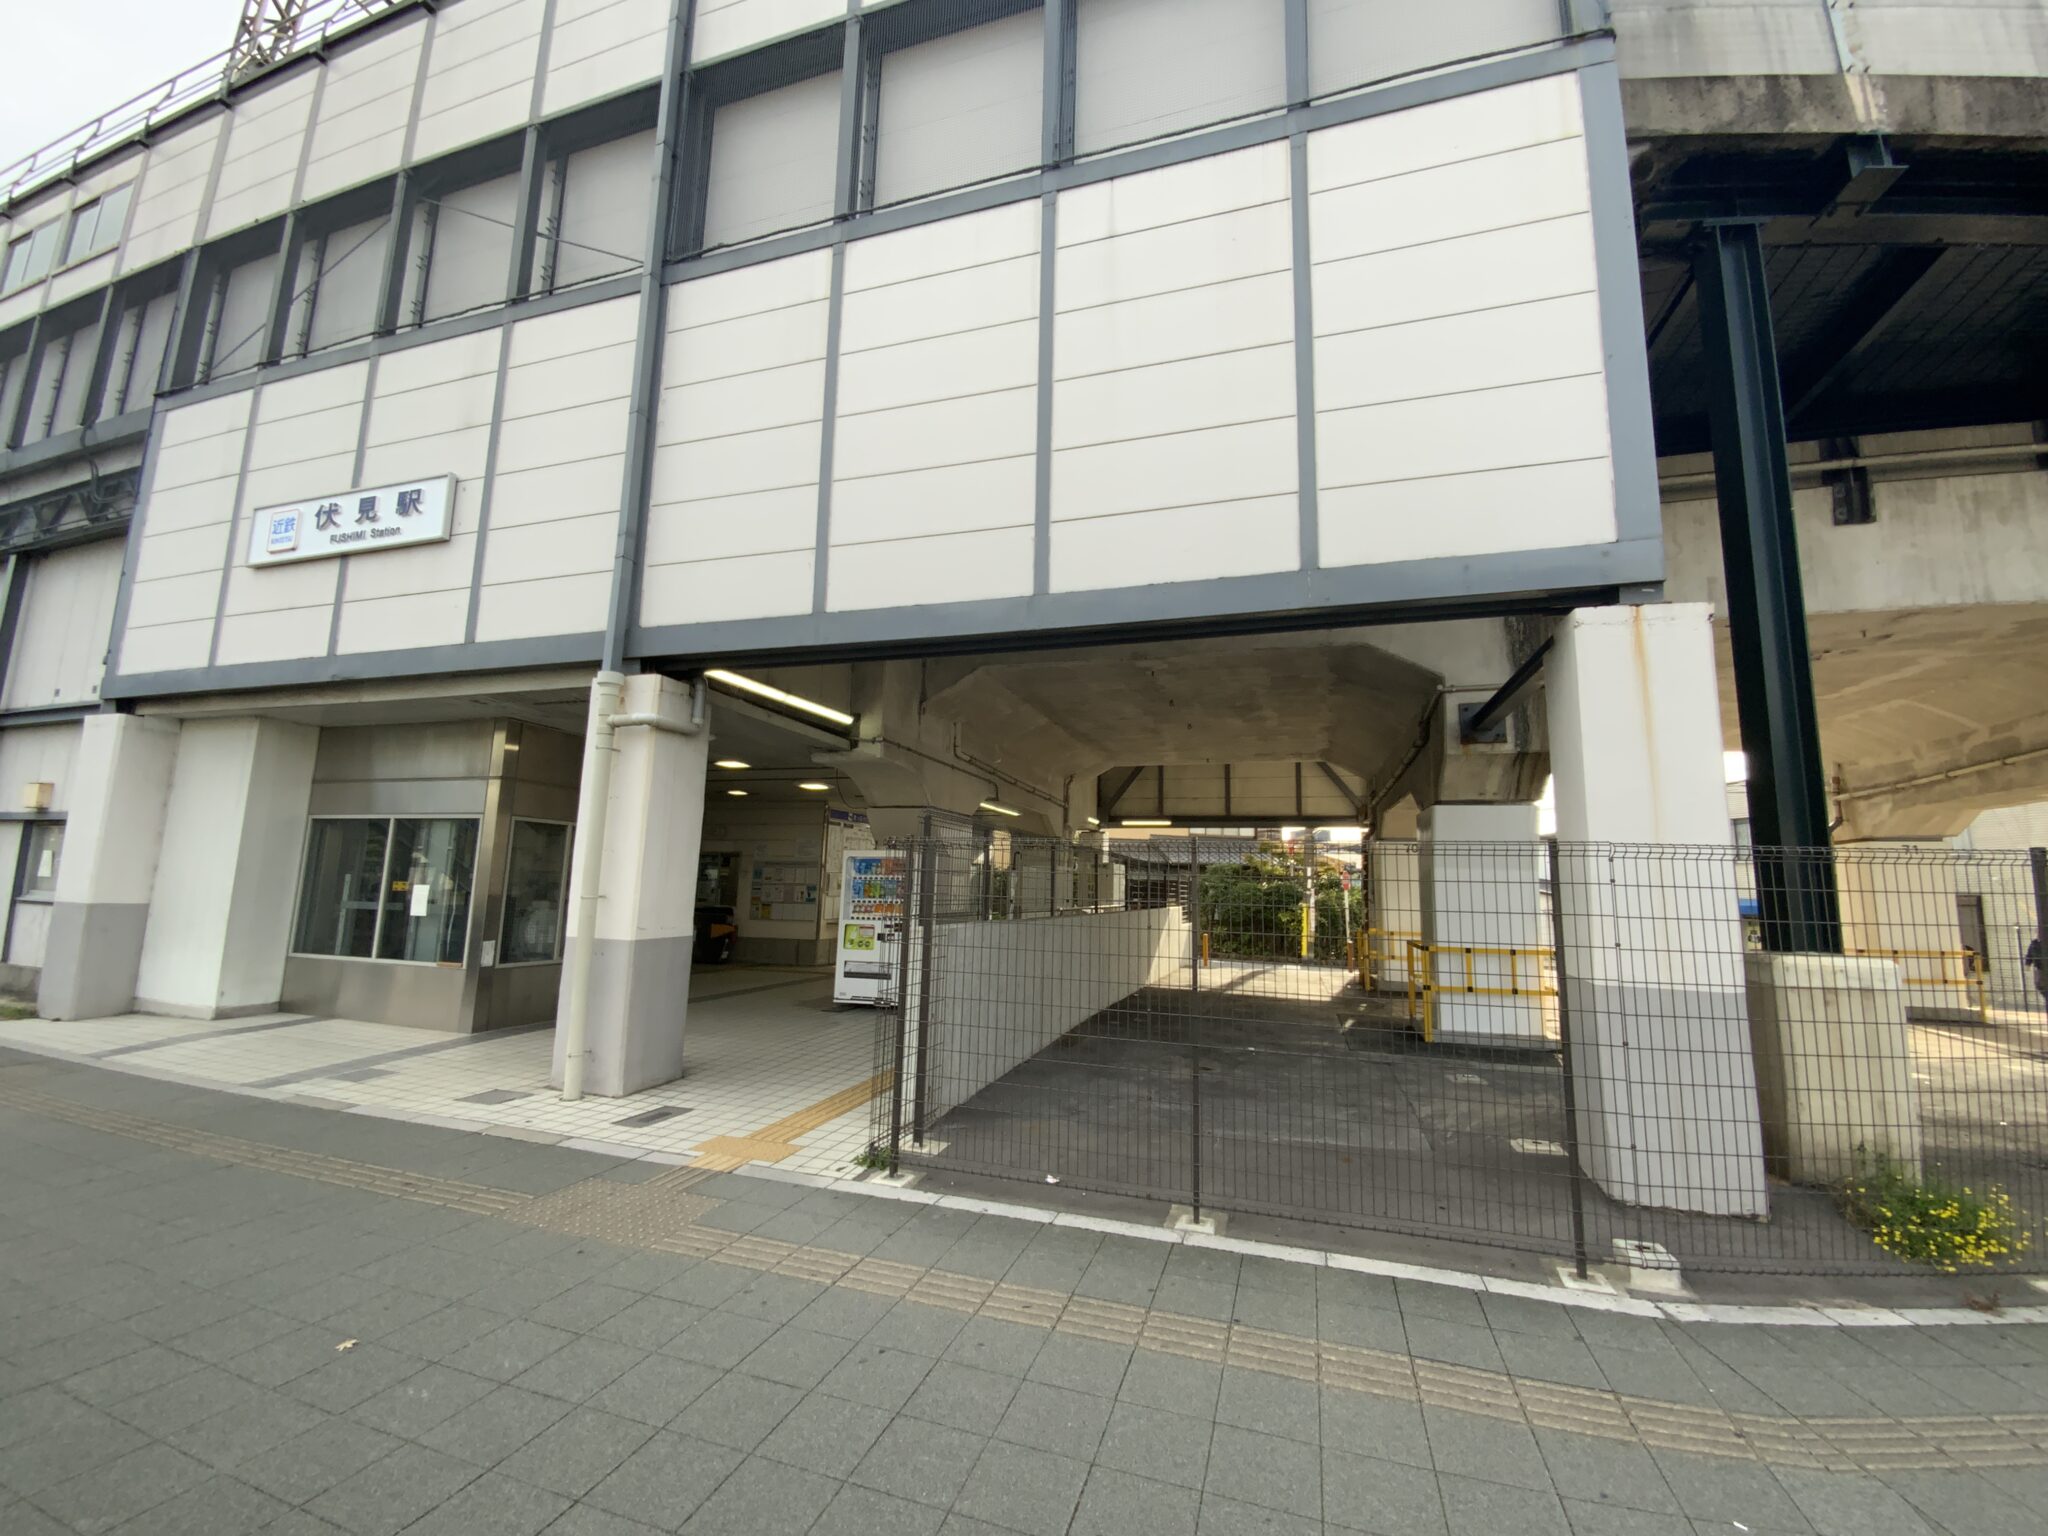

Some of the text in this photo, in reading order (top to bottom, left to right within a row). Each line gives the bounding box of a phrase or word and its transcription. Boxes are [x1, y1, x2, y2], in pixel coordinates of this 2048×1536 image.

[315, 489, 422, 530] 伏見駅
[272, 517, 296, 534] 近鉄
[330, 526, 401, 544] FUSHIMI Station
